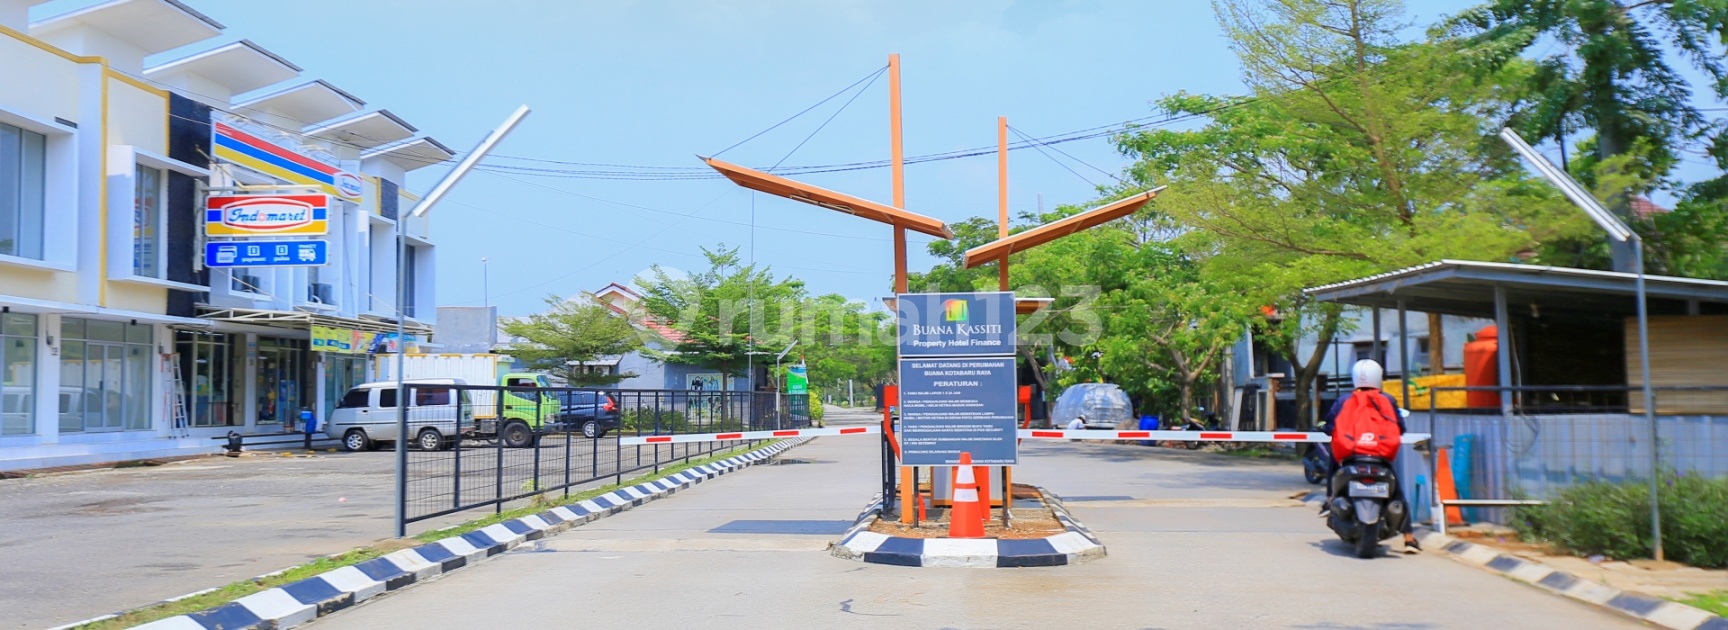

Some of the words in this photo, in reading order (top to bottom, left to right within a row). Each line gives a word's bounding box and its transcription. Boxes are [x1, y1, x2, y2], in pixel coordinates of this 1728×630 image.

[228, 208, 306, 222] Indomaret
[913, 324, 953, 336] BUANA
[957, 323, 1002, 336] KASSITI
[913, 340, 946, 348] Property
